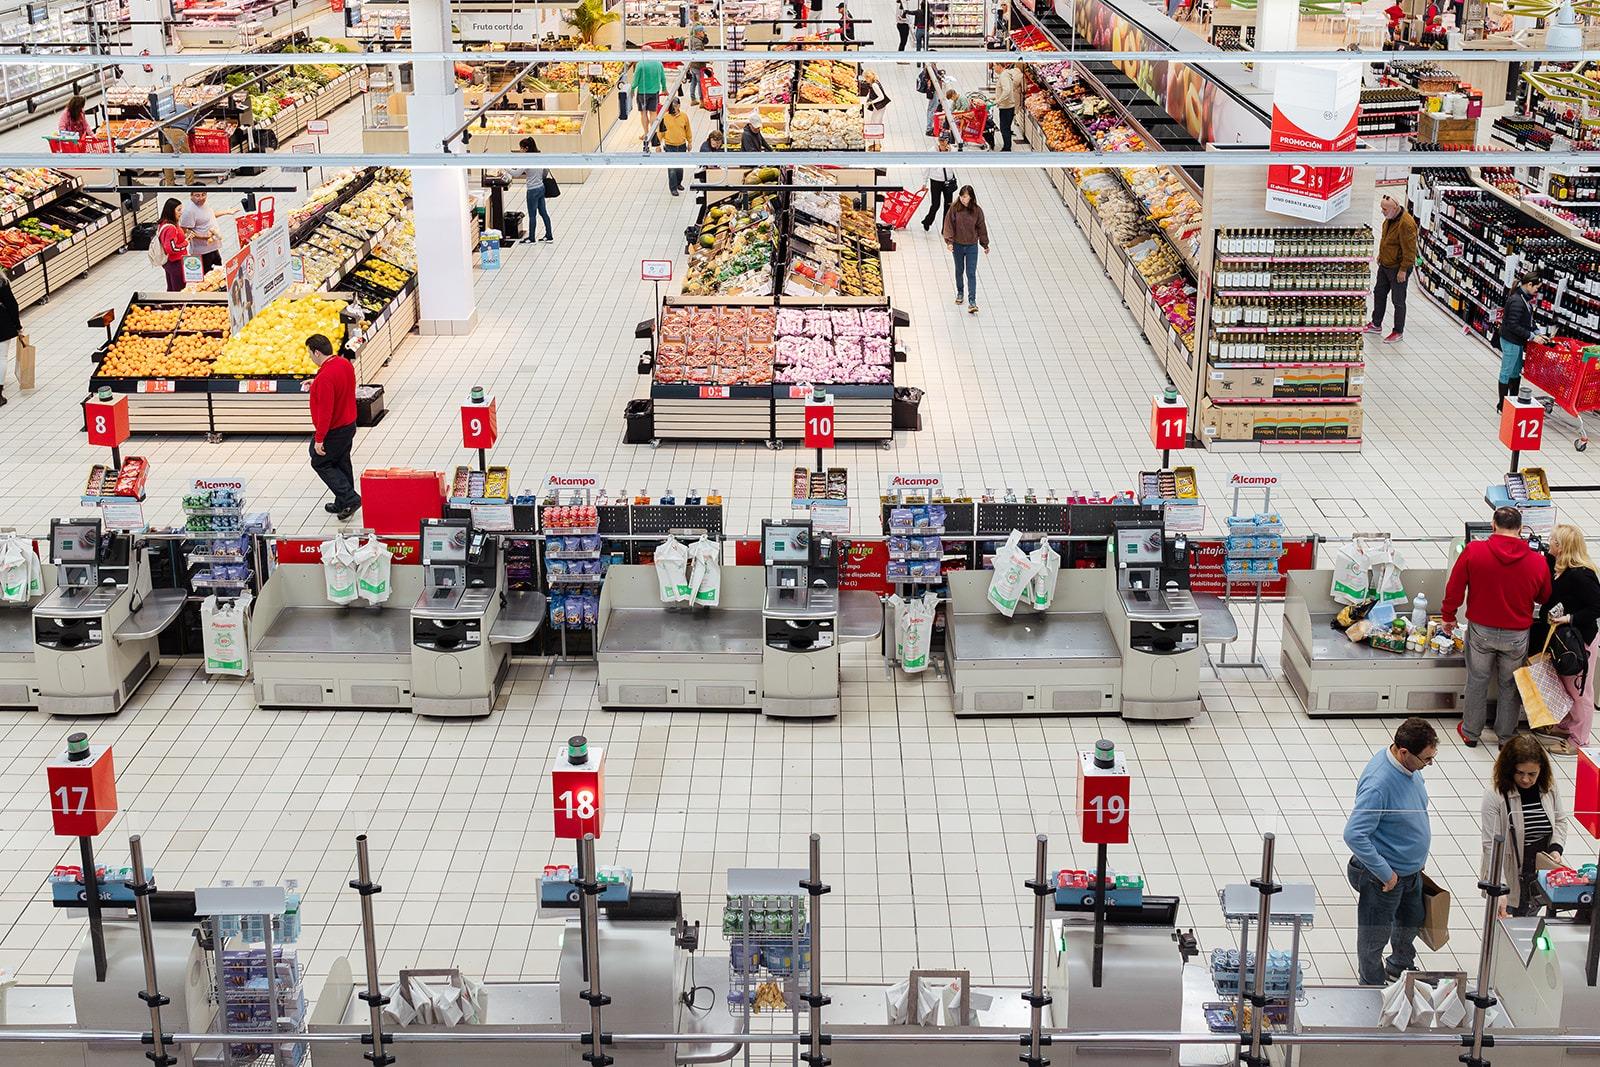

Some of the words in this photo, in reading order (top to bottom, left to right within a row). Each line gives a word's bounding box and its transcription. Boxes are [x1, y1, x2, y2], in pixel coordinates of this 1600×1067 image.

[472, 23, 493, 31] Fruta
[1280, 136, 1322, 150] PROMOCIÓN
[95, 415, 107, 434] 8
[470, 418, 482, 437] 9
[808, 417, 831, 436] 10
[1161, 418, 1184, 437] 11
[1517, 419, 1540, 438] 12
[194, 479, 242, 490] Alcampo
[548, 475, 595, 486] Alcampo
[892, 476, 939, 487] Alcampo
[1230, 474, 1277, 485] Alcampo
[300, 544, 315, 553] Las
[54, 786, 89, 816] 17
[558, 790, 595, 820] 18
[1089, 795, 1126, 825] 19
